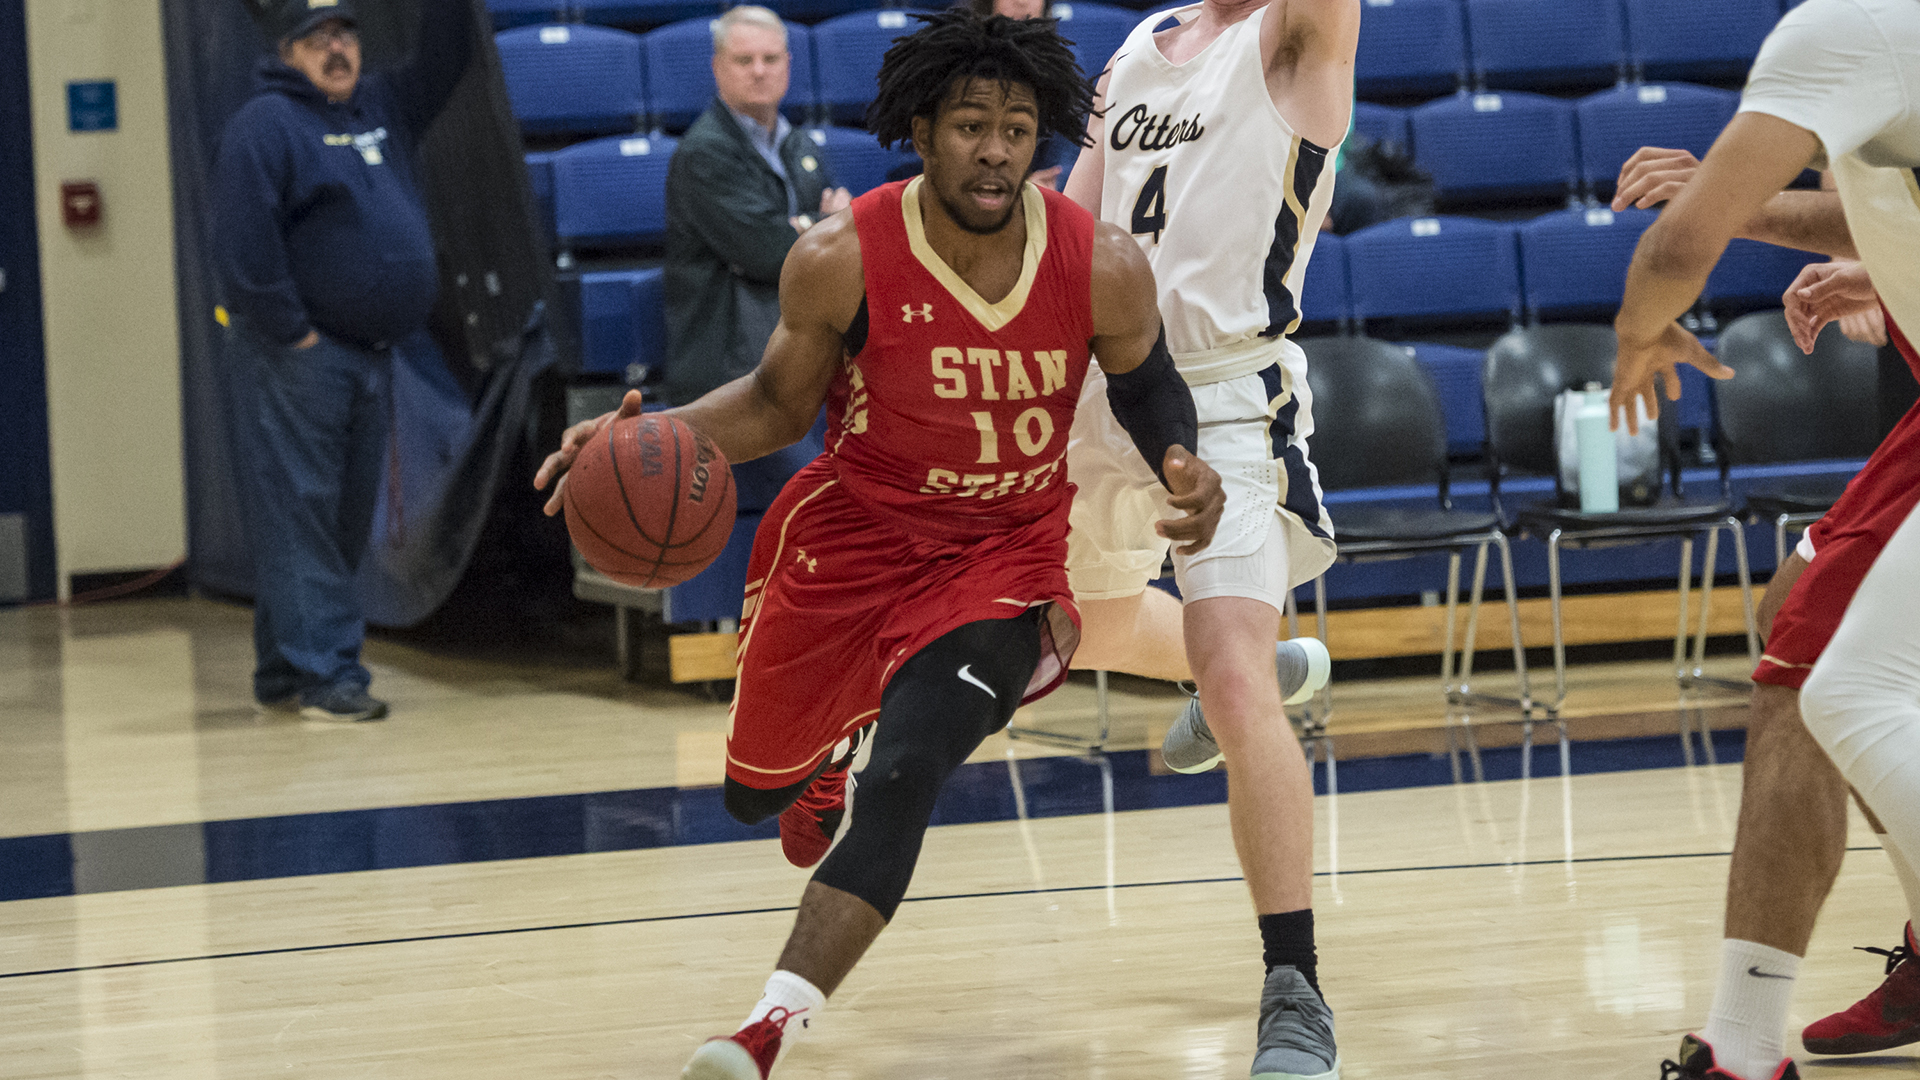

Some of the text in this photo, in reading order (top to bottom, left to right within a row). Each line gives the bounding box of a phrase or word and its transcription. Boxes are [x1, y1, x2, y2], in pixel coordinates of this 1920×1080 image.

[1110, 103, 1205, 151] Otters
[1131, 164, 1169, 246] 4
[931, 346, 1067, 400] STAN
[970, 407, 1054, 464] 10
